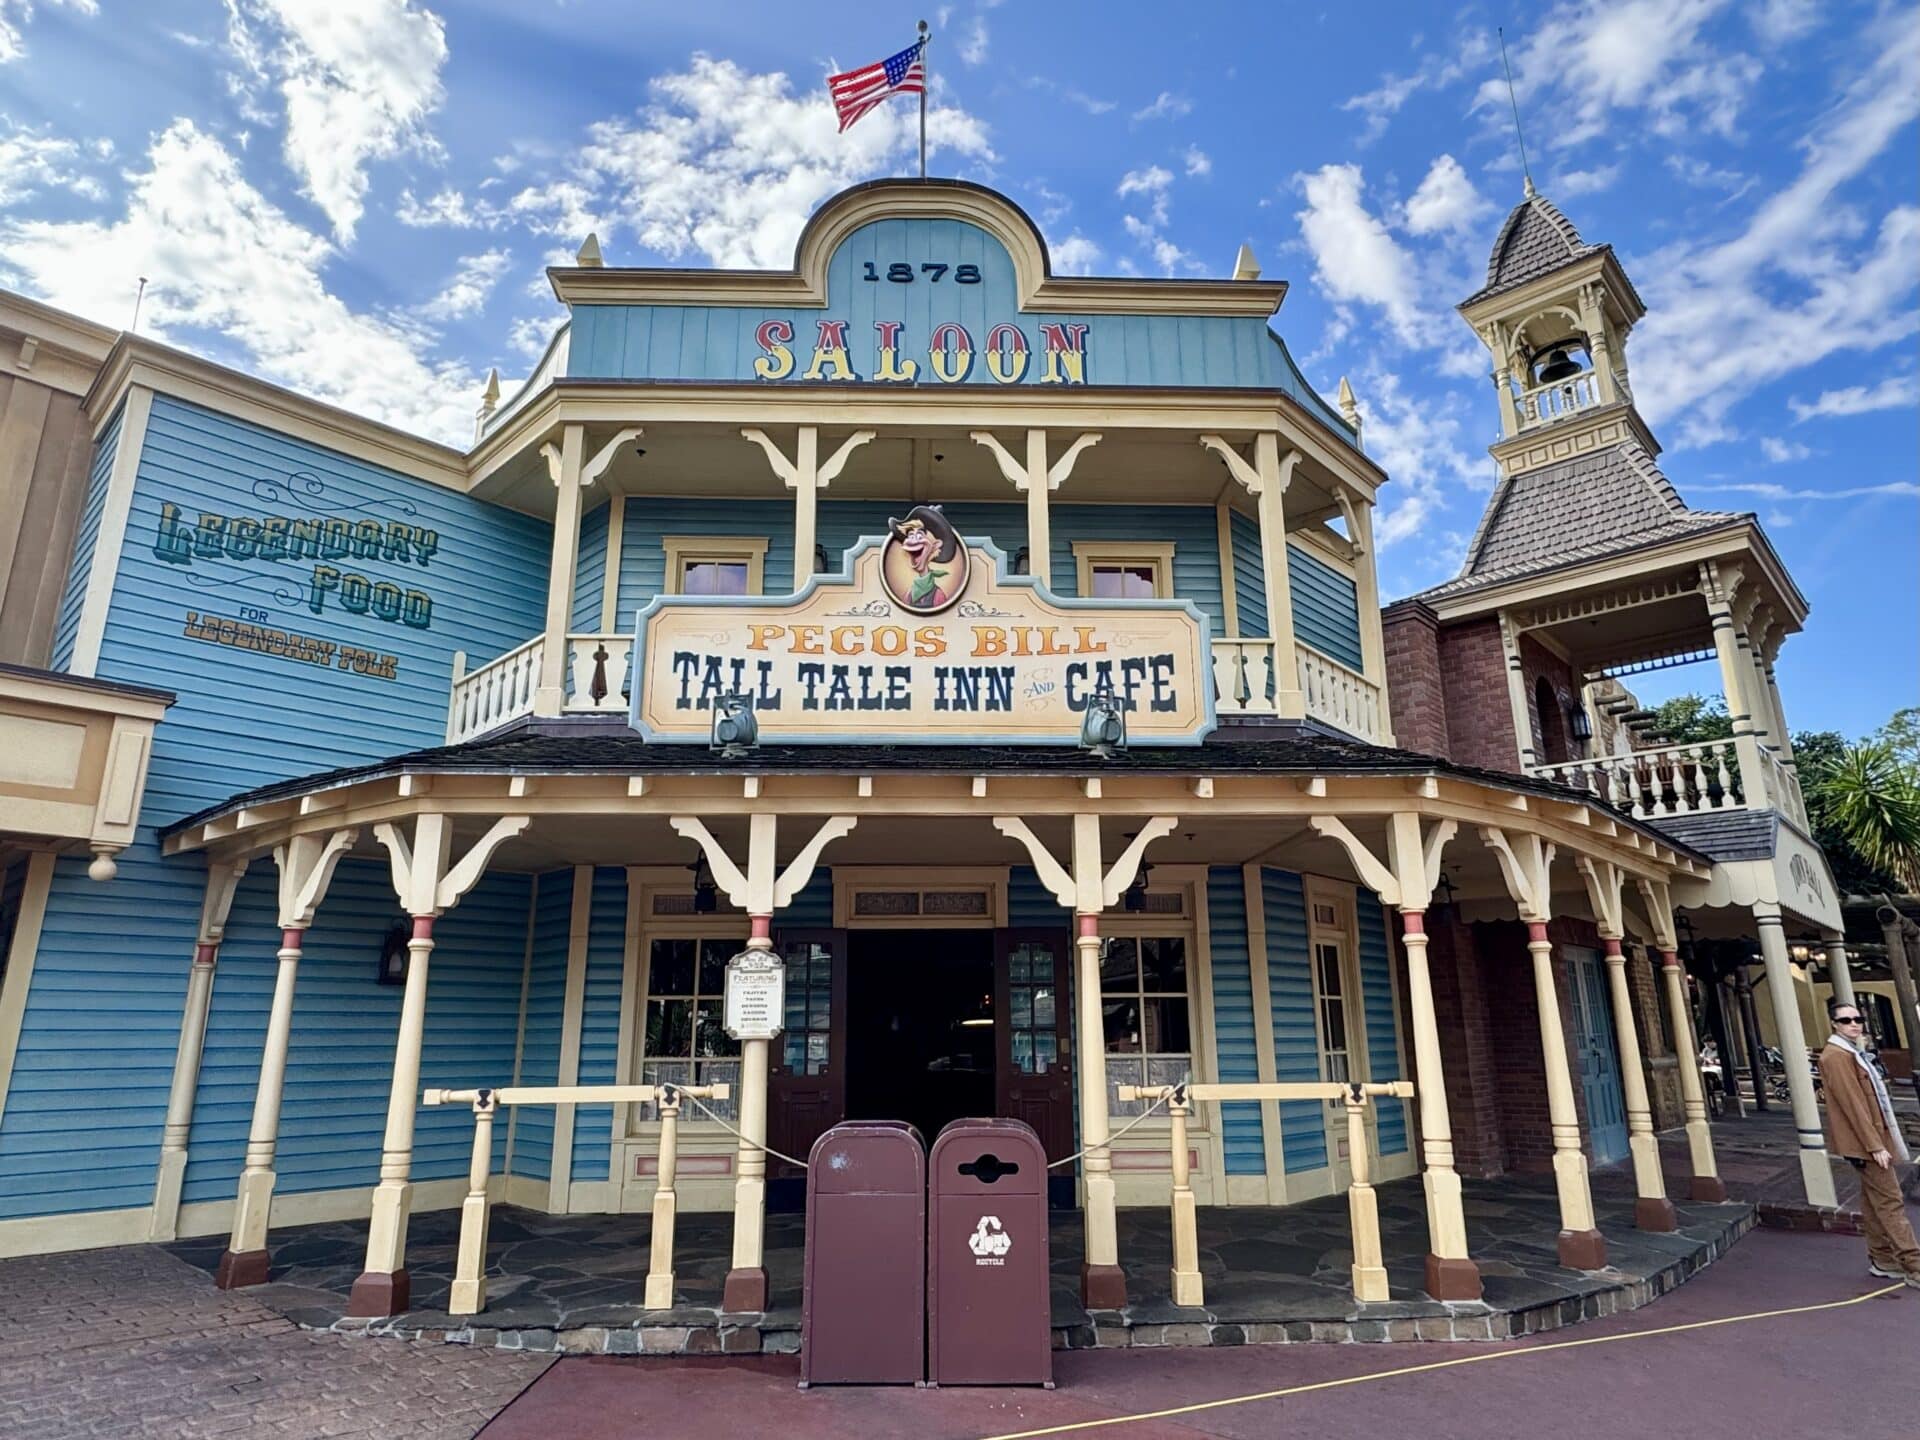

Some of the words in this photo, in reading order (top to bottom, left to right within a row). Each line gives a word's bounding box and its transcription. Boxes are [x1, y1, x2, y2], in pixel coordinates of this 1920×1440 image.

[863, 262, 982, 284] 1878
[754, 320, 1089, 385] SALOON
[152, 501, 438, 567] LEGENDARY
[240, 606, 269, 623] FOR
[308, 564, 432, 630] FOOD
[184, 611, 336, 666] LEGENDARY
[338, 645, 398, 680] FOLK
[747, 625, 947, 657] PECOS
[970, 626, 1107, 657] BILL
[673, 651, 782, 710] TALL
[798, 662, 911, 711] TALE
[934, 666, 1015, 712] INN
[1065, 653, 1177, 712] CAFE
[734, 975, 777, 983] FEATURING
